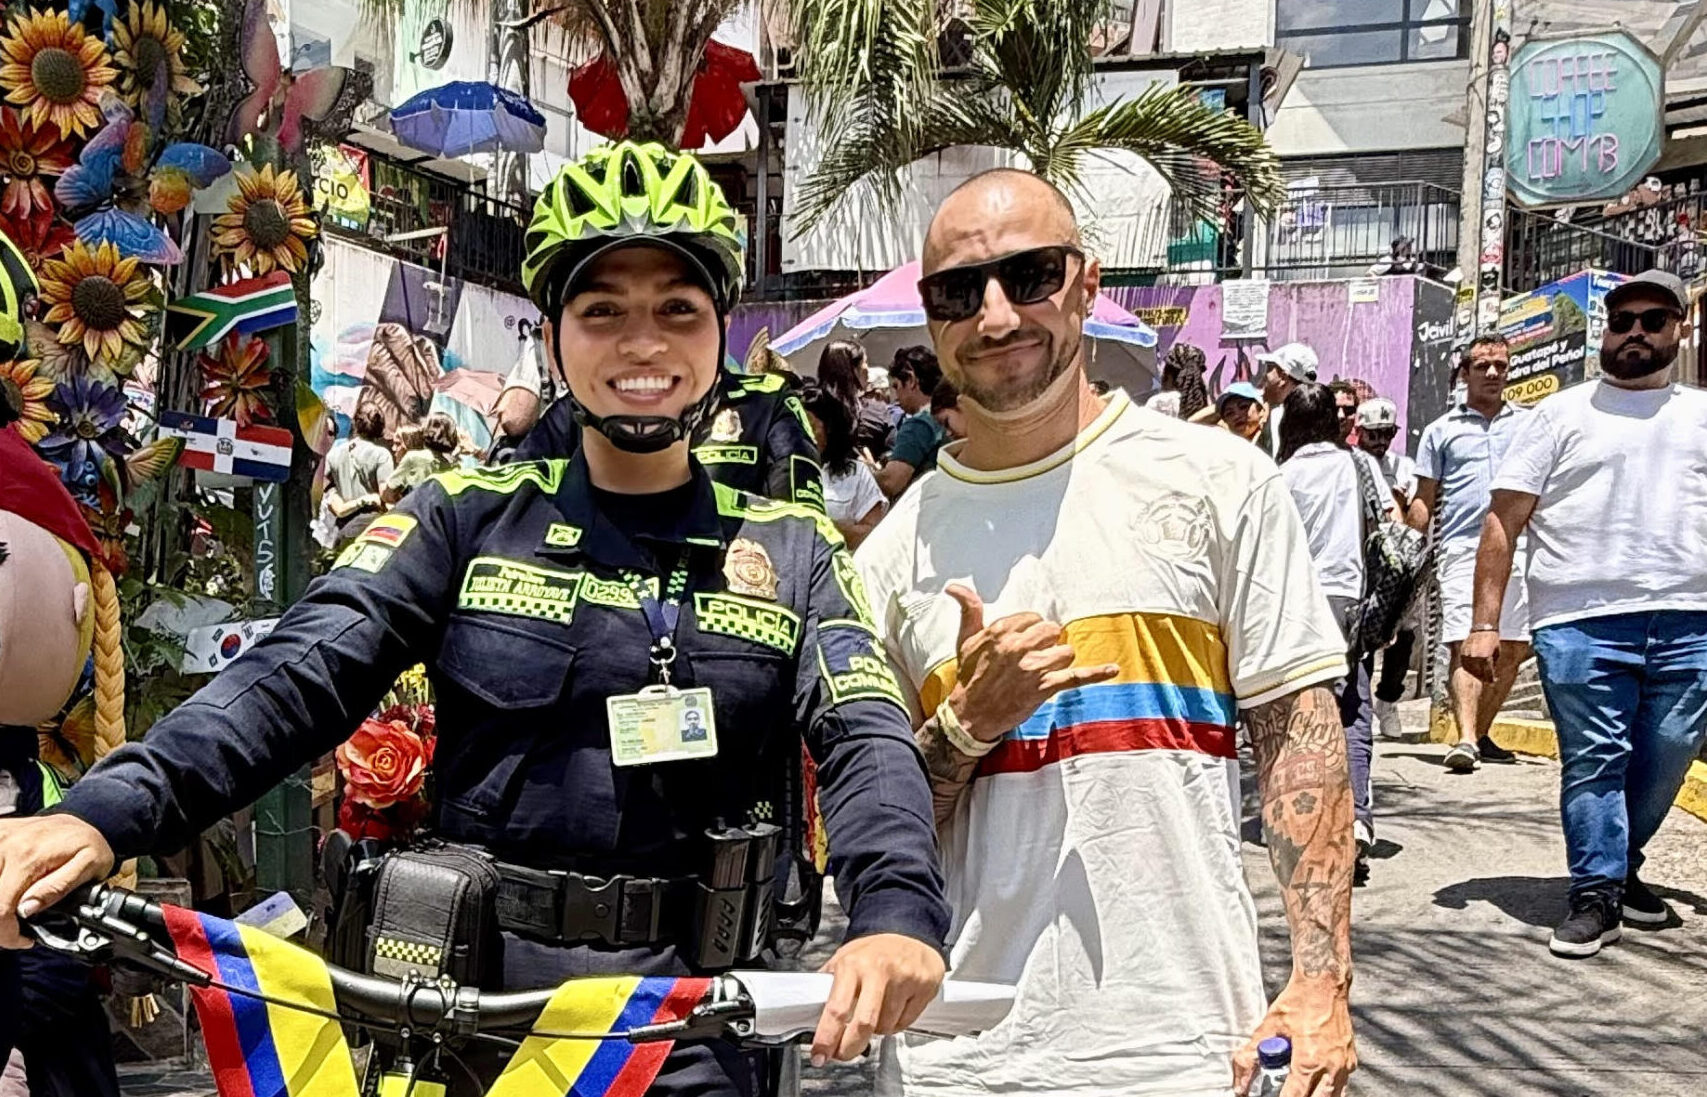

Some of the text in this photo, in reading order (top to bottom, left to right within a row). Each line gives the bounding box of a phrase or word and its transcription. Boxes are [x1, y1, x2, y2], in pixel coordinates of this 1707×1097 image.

[1530, 51, 1617, 98] COFFEE
[314, 178, 348, 200] CIO
[1509, 340, 1568, 367] Guatapé y
[1531, 356, 1550, 372] del
[1551, 345, 1585, 367] Peñol
[708, 600, 791, 637] POLICÍA
